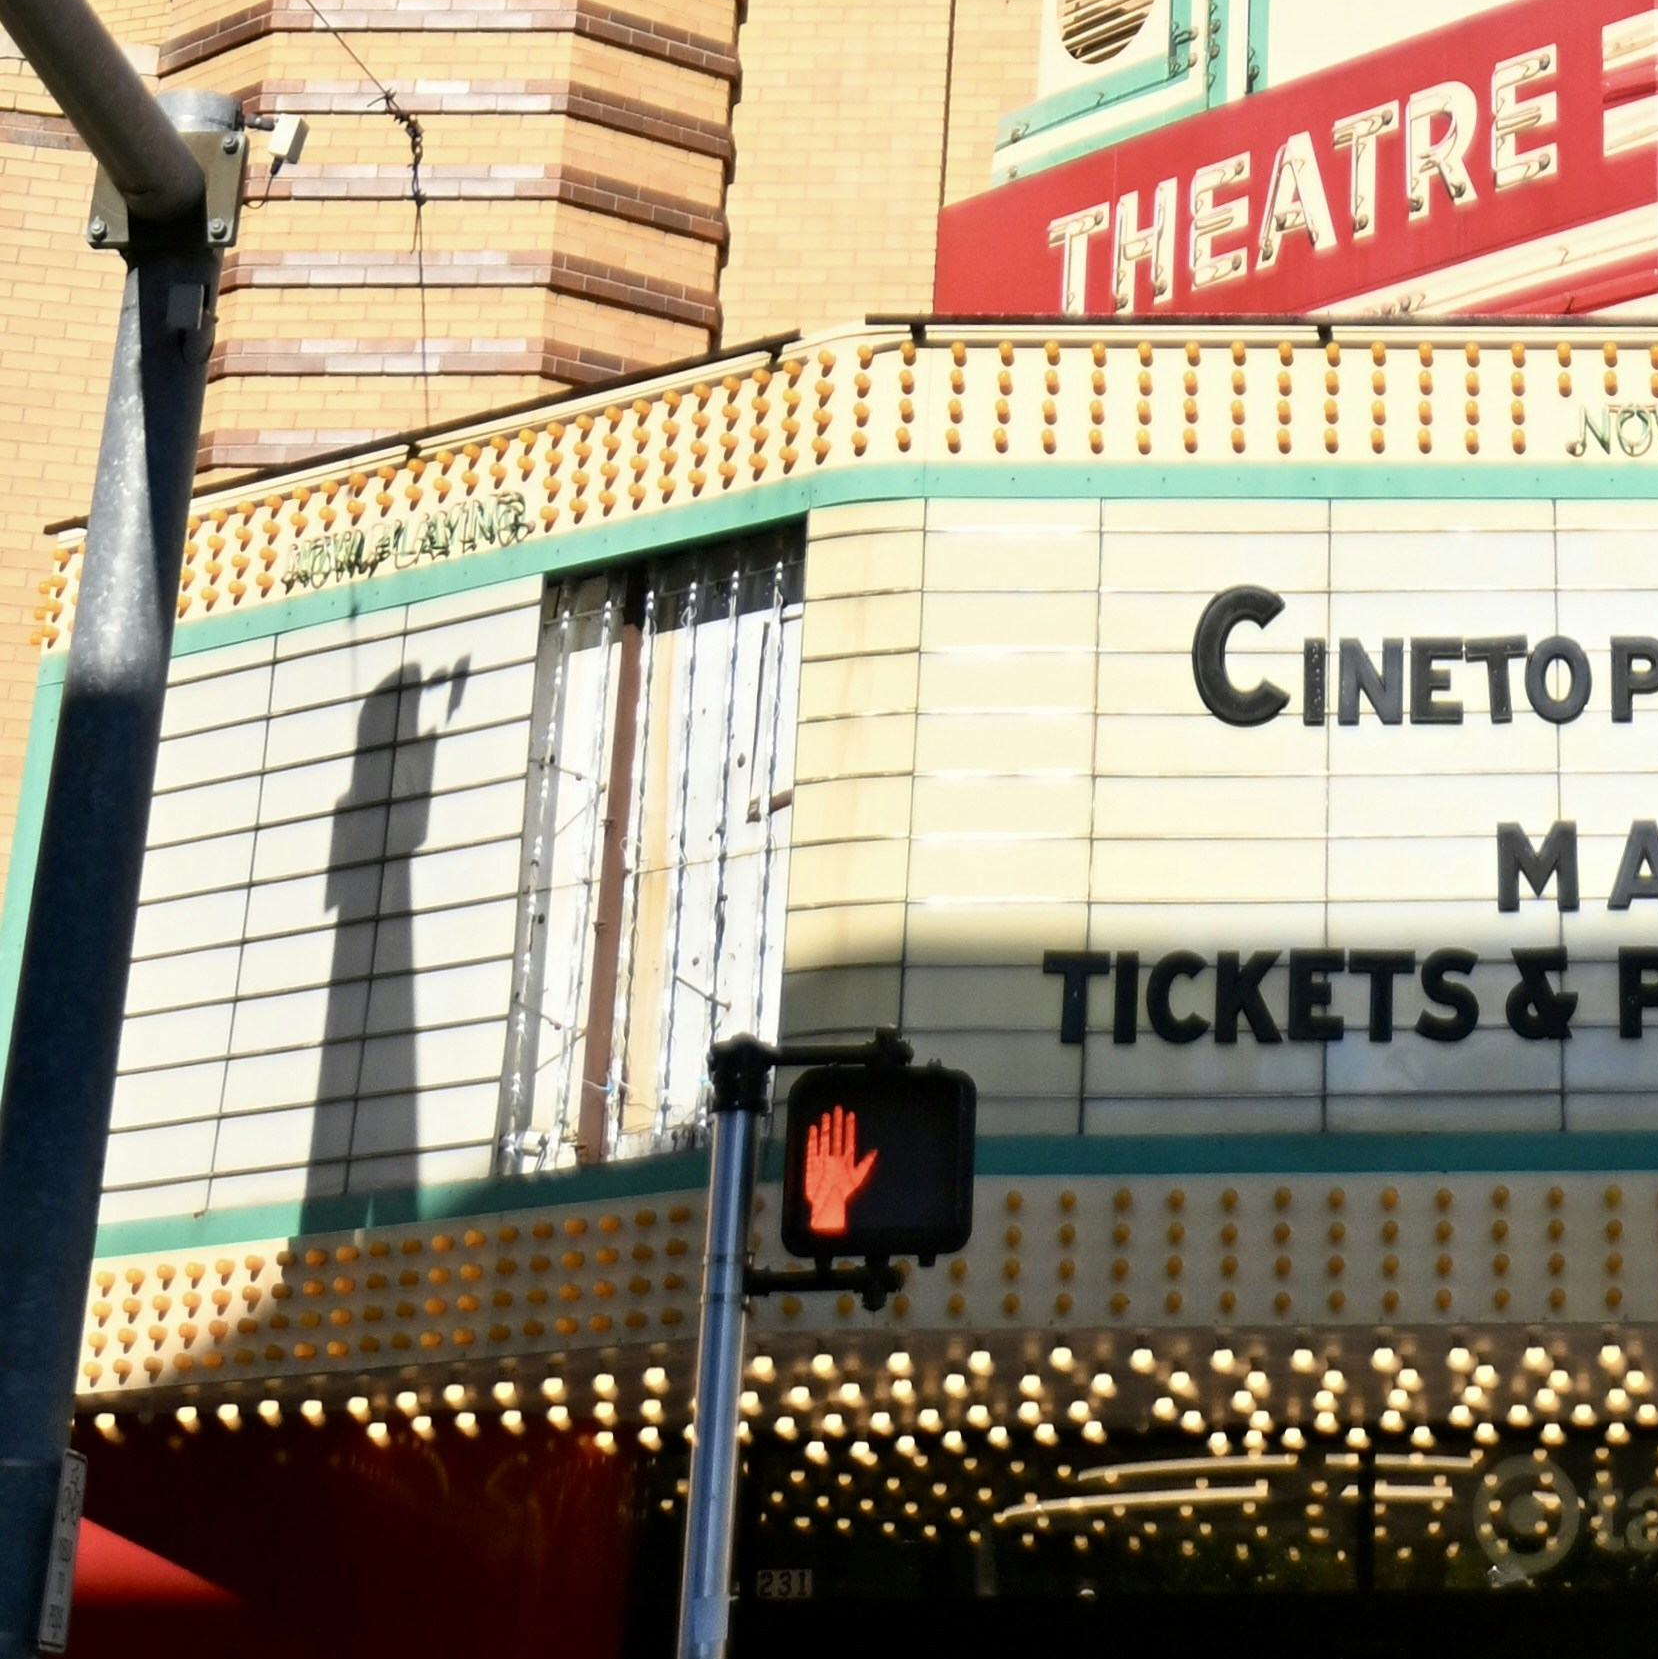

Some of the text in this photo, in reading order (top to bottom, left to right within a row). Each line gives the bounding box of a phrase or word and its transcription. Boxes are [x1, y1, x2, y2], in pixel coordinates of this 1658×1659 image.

[1046, 42, 1559, 316] THEATRE
[1042, 946, 1481, 1044] TICKETS
[1504, 944, 1579, 1041] &
[759, 1569, 808, 1598] 231
